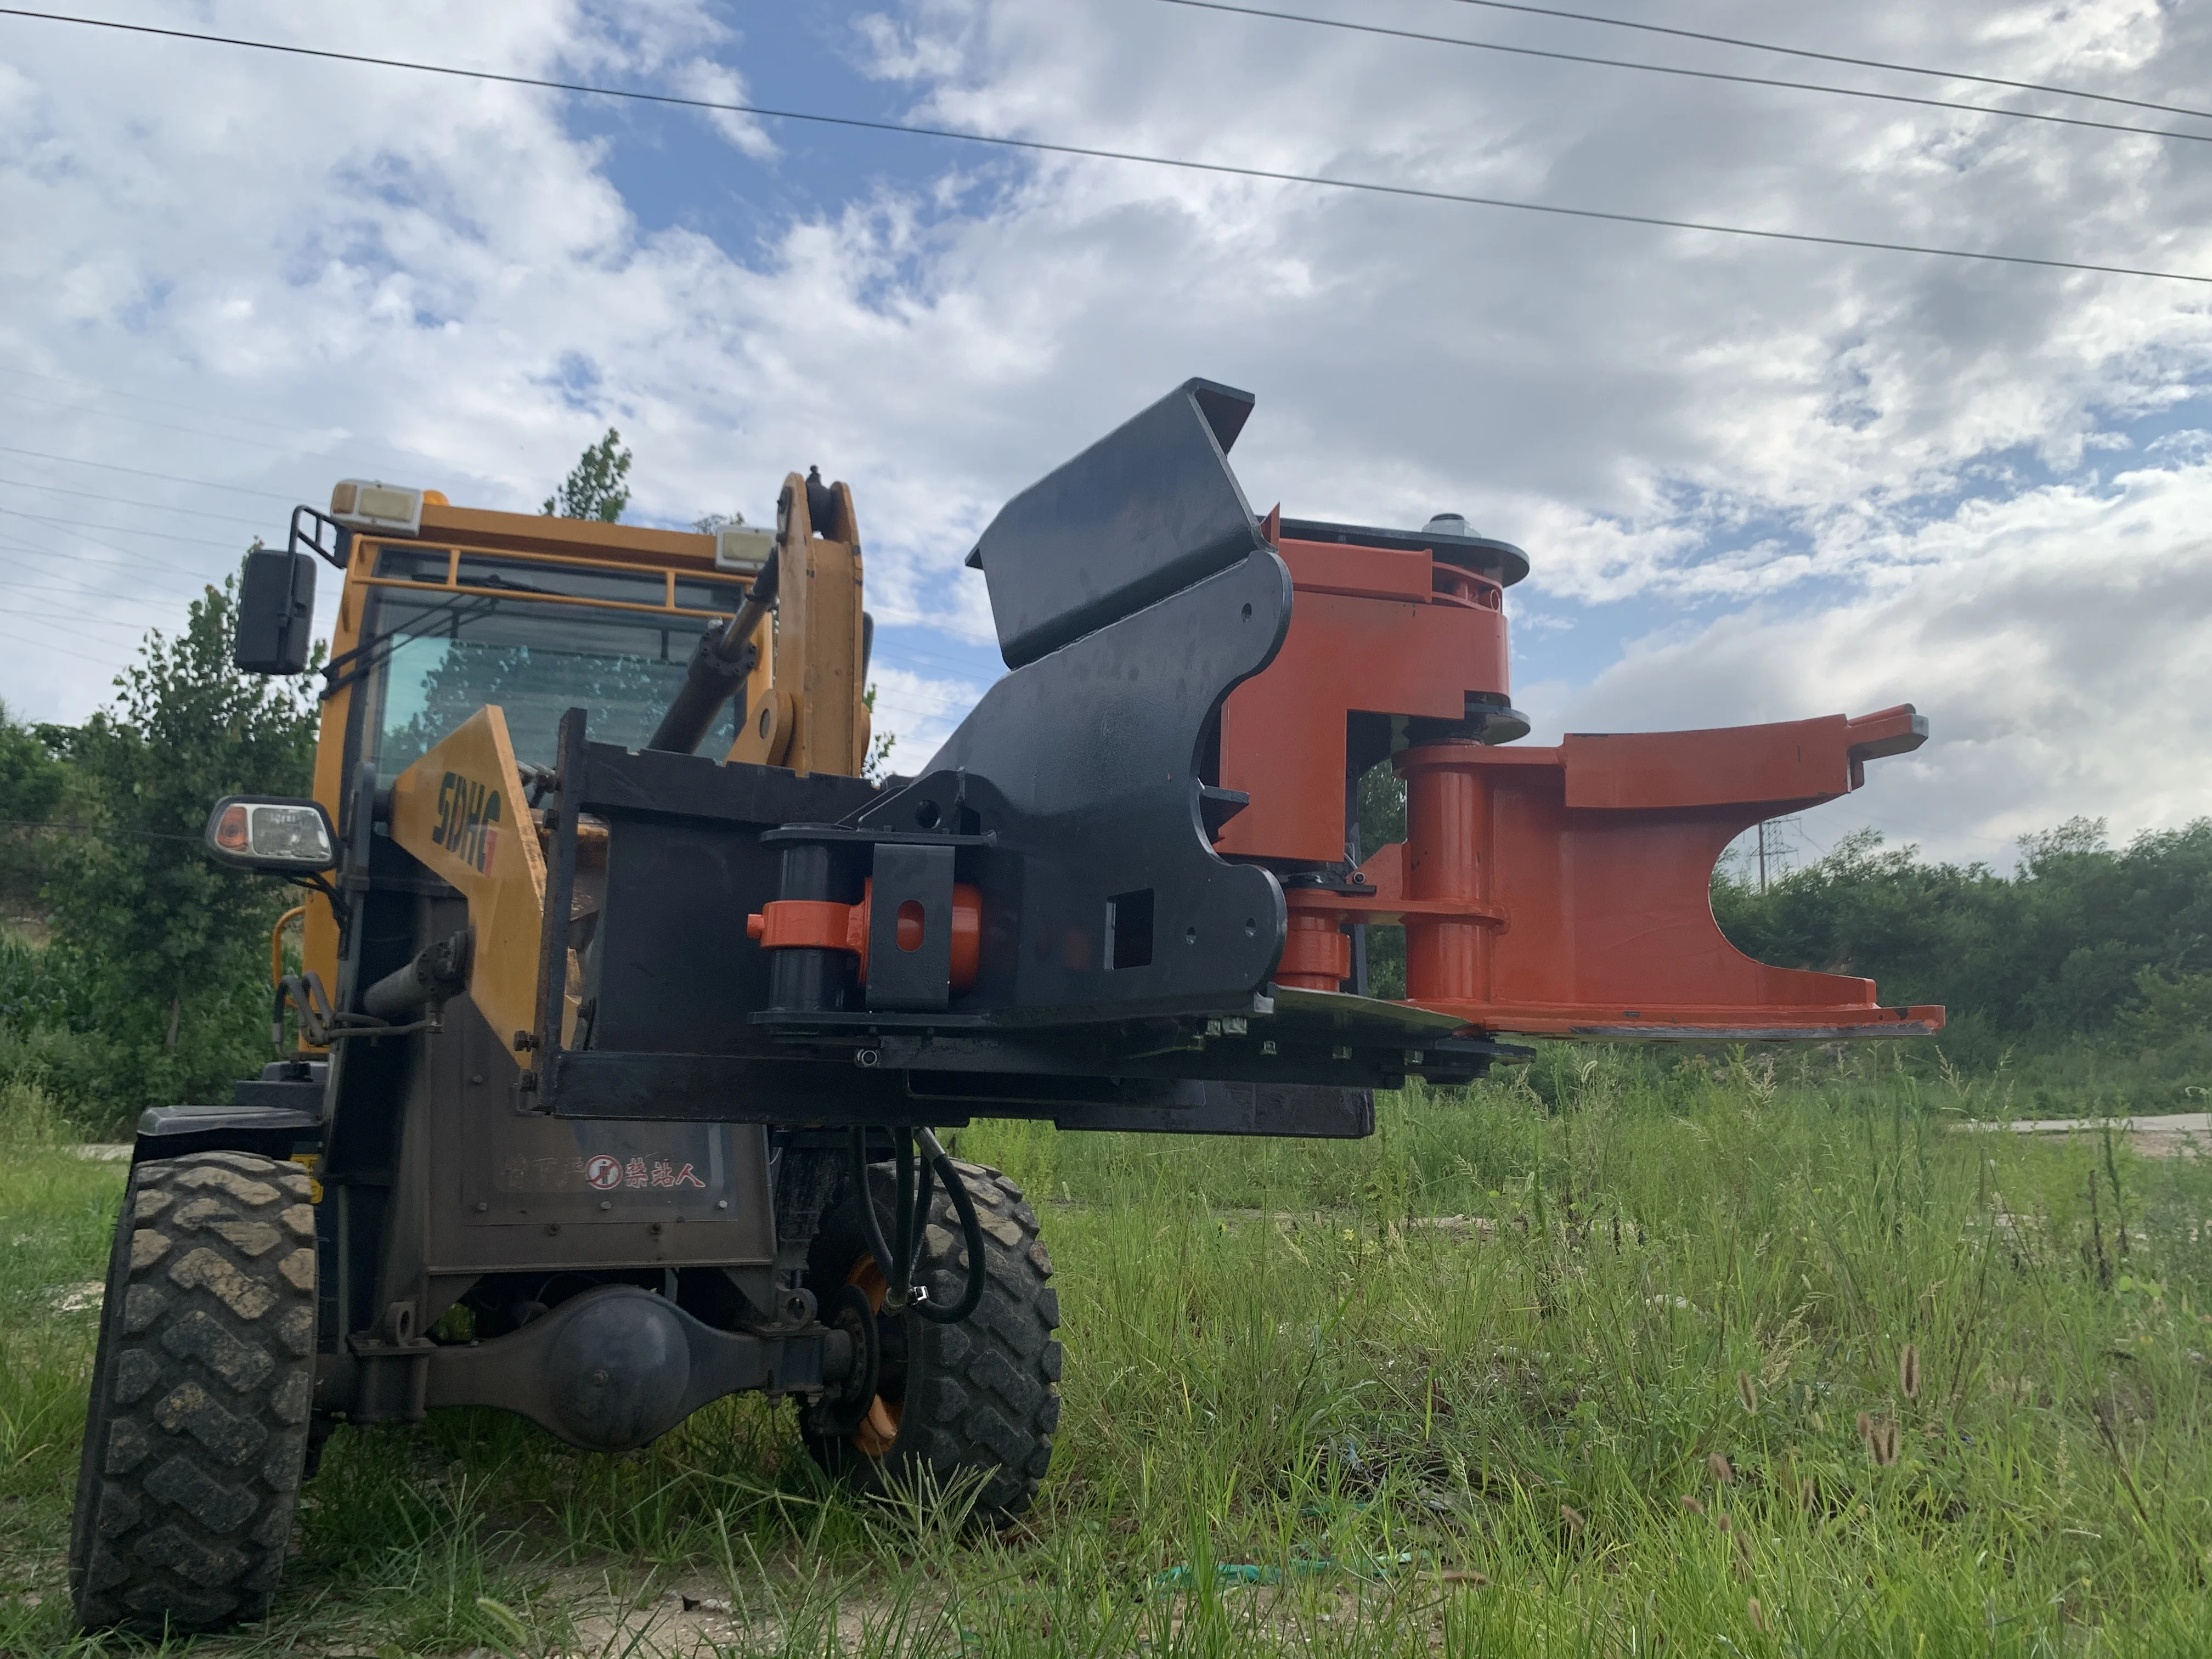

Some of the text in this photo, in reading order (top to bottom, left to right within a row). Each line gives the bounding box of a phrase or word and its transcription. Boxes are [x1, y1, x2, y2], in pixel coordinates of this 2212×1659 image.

[432, 771, 501, 877] SDHG
[626, 1155, 706, 1188] 禁站人
